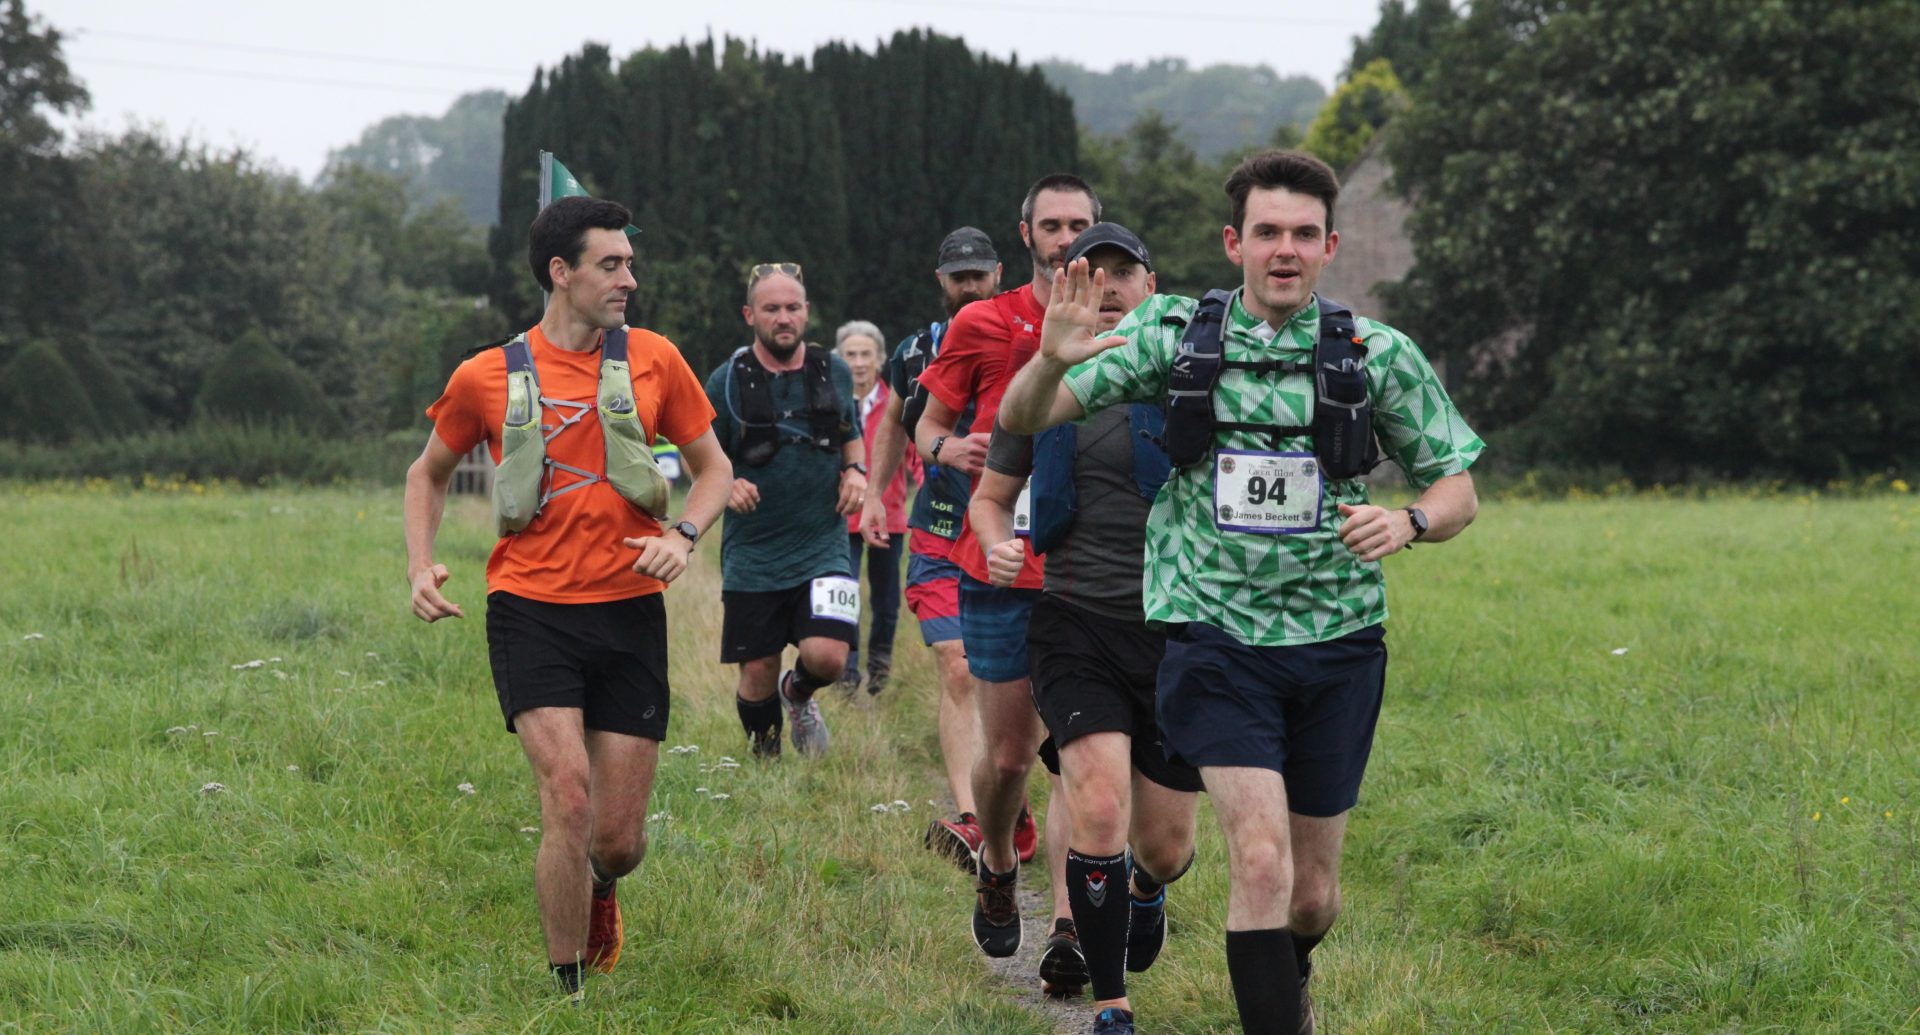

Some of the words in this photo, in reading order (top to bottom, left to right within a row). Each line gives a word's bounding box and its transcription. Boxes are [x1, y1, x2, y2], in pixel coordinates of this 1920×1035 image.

[1247, 476, 1287, 506] 94
[1233, 511, 1262, 520] James
[1265, 512, 1300, 522] Beckett
[827, 589, 856, 609] 104
